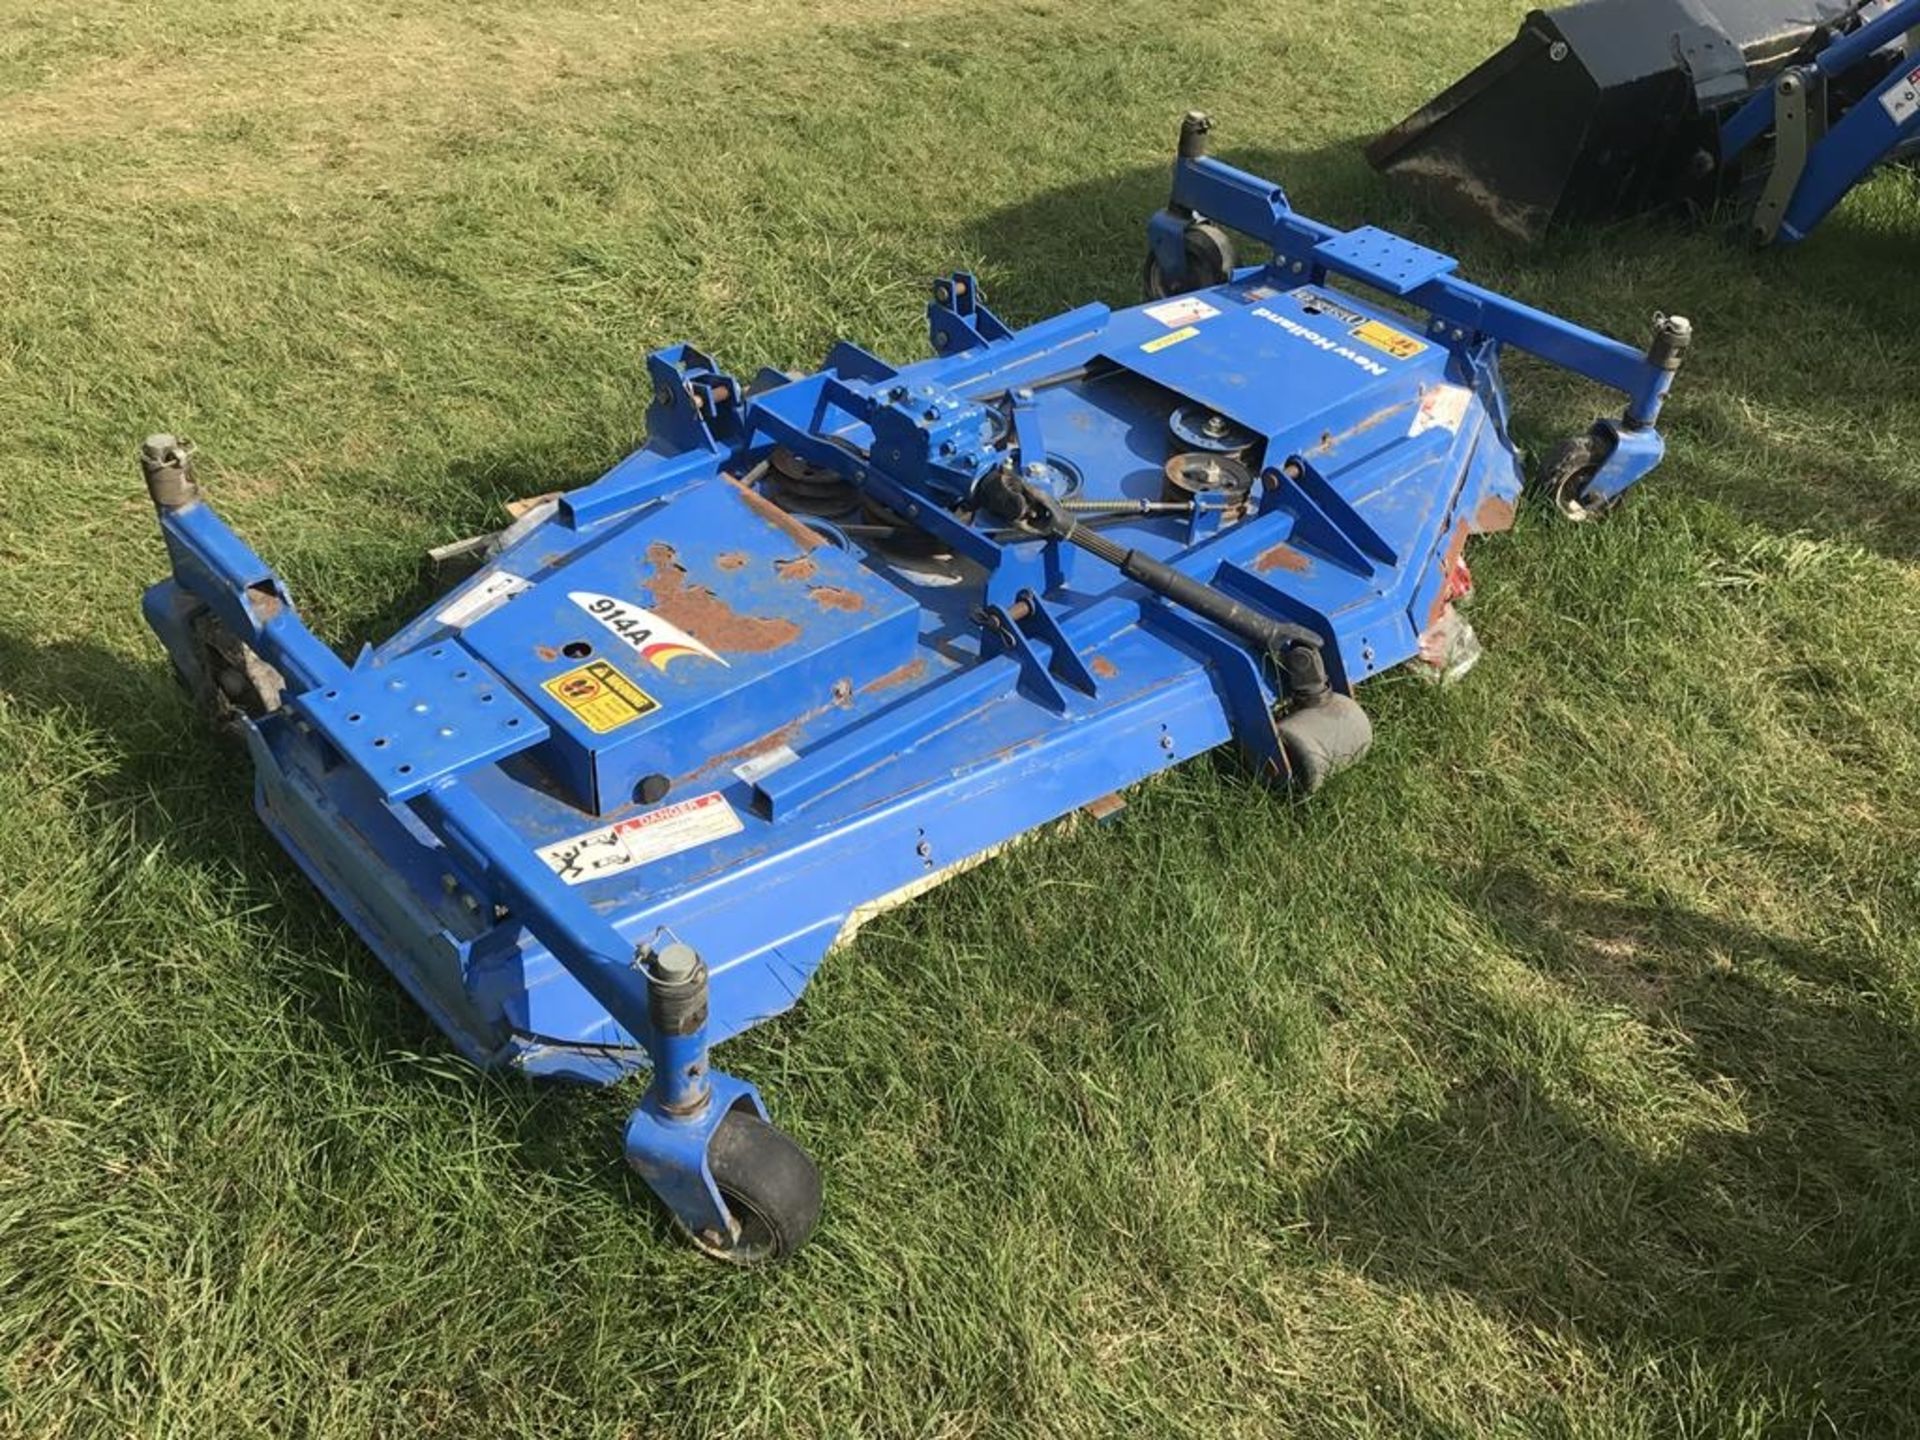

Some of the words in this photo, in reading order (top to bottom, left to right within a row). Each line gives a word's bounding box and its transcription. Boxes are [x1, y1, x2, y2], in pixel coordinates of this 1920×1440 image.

[1251, 307, 1337, 350] Holland
[1333, 347, 1388, 376] New
[588, 599, 652, 646] 914A
[640, 801, 698, 826] DANGER
